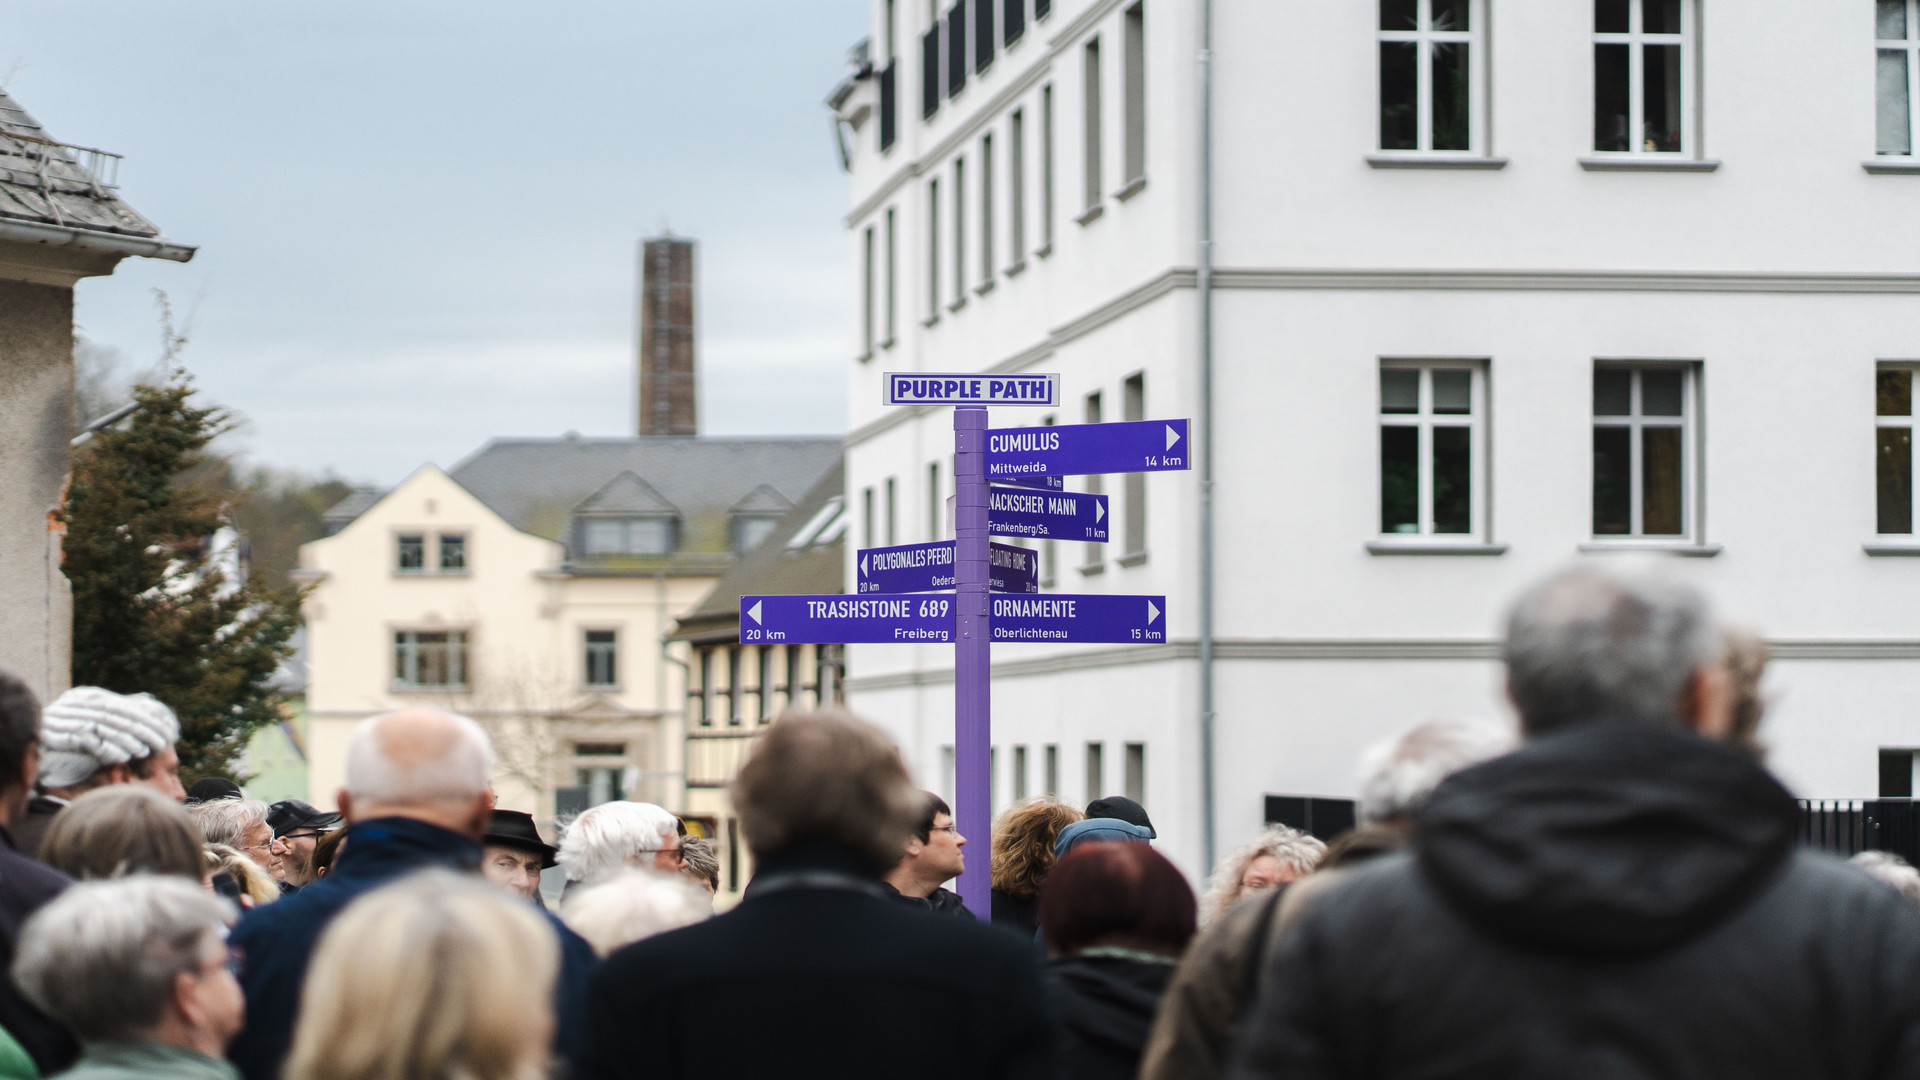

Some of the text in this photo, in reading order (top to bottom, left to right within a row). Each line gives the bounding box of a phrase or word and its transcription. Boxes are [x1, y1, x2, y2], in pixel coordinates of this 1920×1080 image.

[897, 380, 1045, 398] PURPLE PATH
[990, 432, 1060, 453] CUMULUS
[1145, 455, 1182, 467] 14 km
[990, 462, 1047, 474] Mittweida
[1047, 476, 1062, 488] 18 km
[989, 493, 1076, 516] NACKSCHER MANN
[989, 521, 1050, 536] Frankenberg/Sa.
[1086, 527, 1105, 538] 11 km
[873, 550, 925, 571] POLYGONALES
[927, 547, 952, 566] PFERD
[990, 550, 1026, 571] FLOATING HOME
[860, 582, 879, 592] 20 km
[807, 600, 949, 618] TRASHSTONE 689
[994, 599, 1076, 618] ORNAMENTE
[746, 629, 786, 640] 20 km
[895, 628, 949, 641] Freiberg
[994, 627, 1068, 639] Oberlichtenau
[1131, 629, 1161, 639] 15 km
